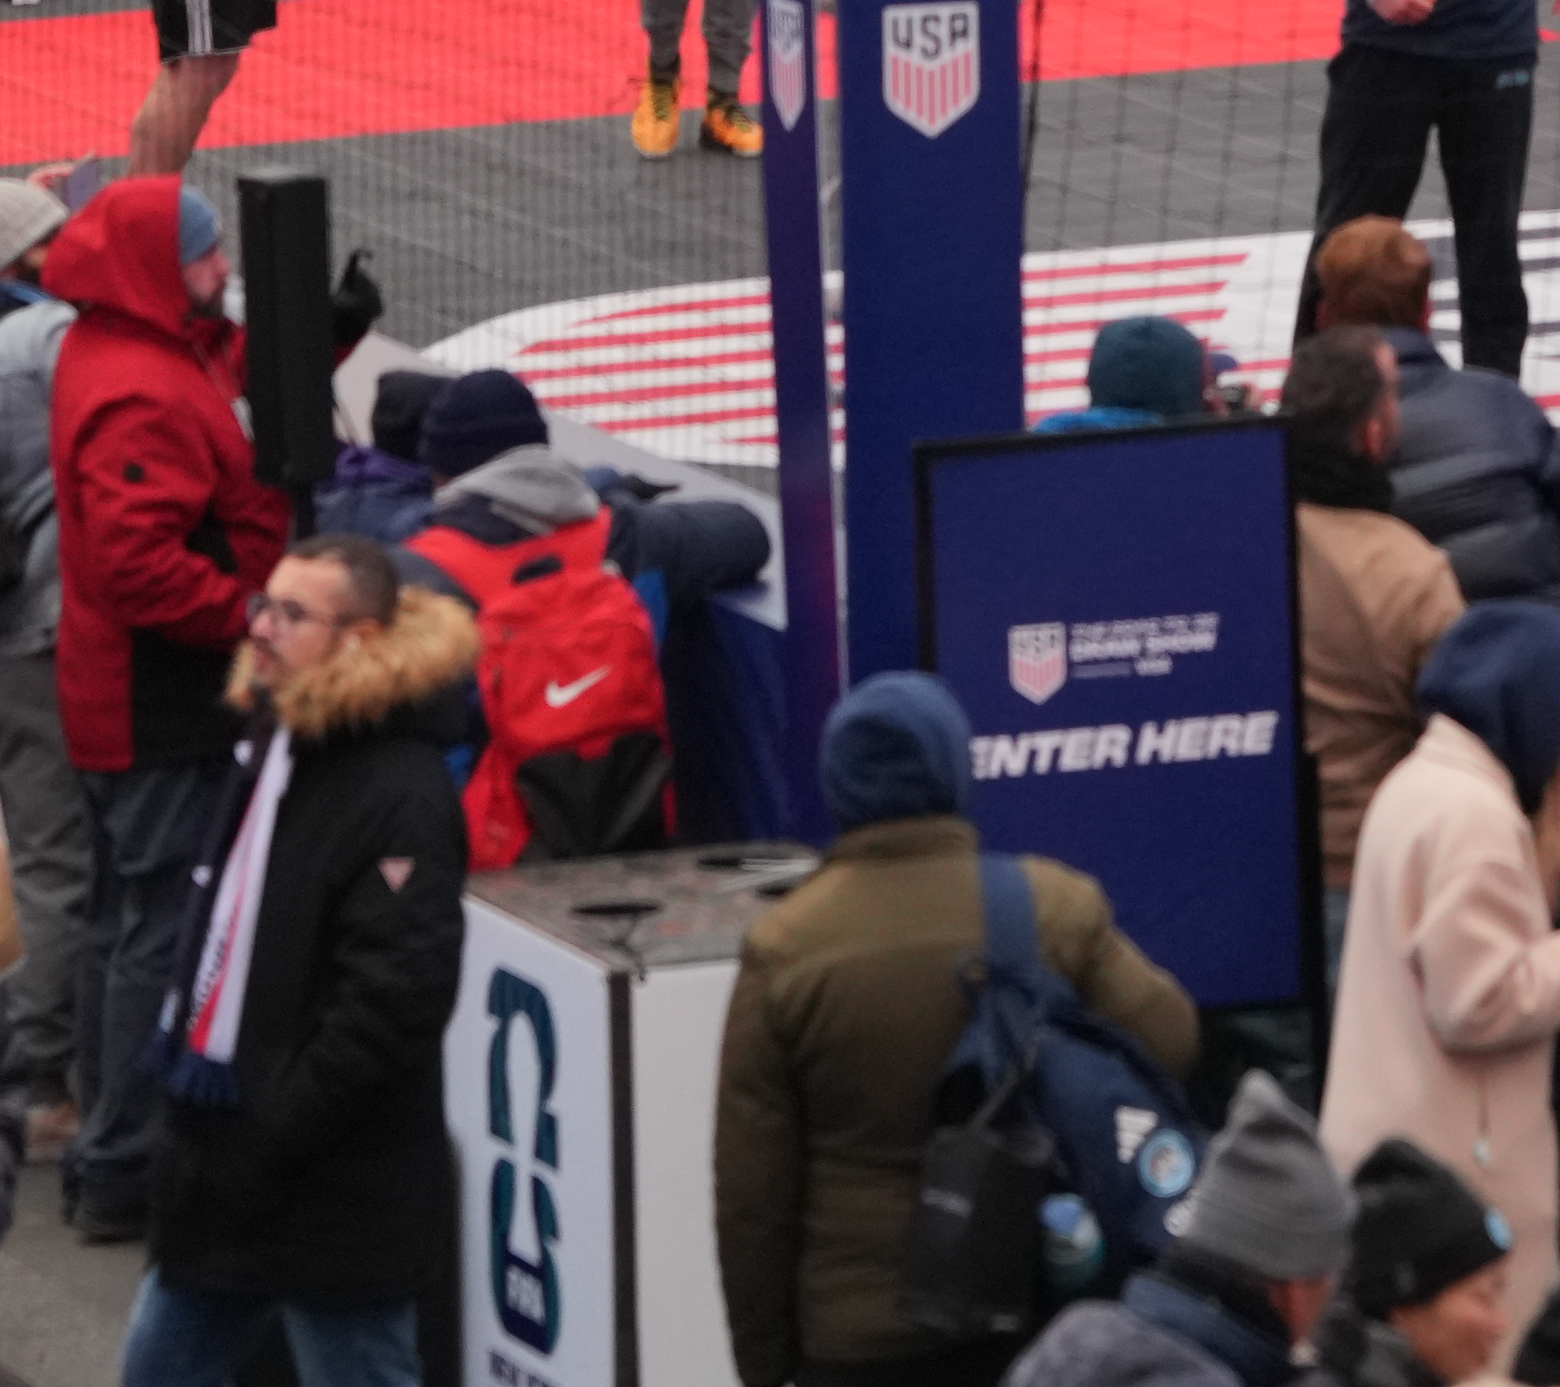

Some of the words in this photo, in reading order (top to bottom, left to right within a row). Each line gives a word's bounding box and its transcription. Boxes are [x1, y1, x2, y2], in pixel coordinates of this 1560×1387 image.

[890, 11, 970, 61] USA
[969, 723, 1135, 781] ENTER
[1135, 709, 1281, 768] HERE
